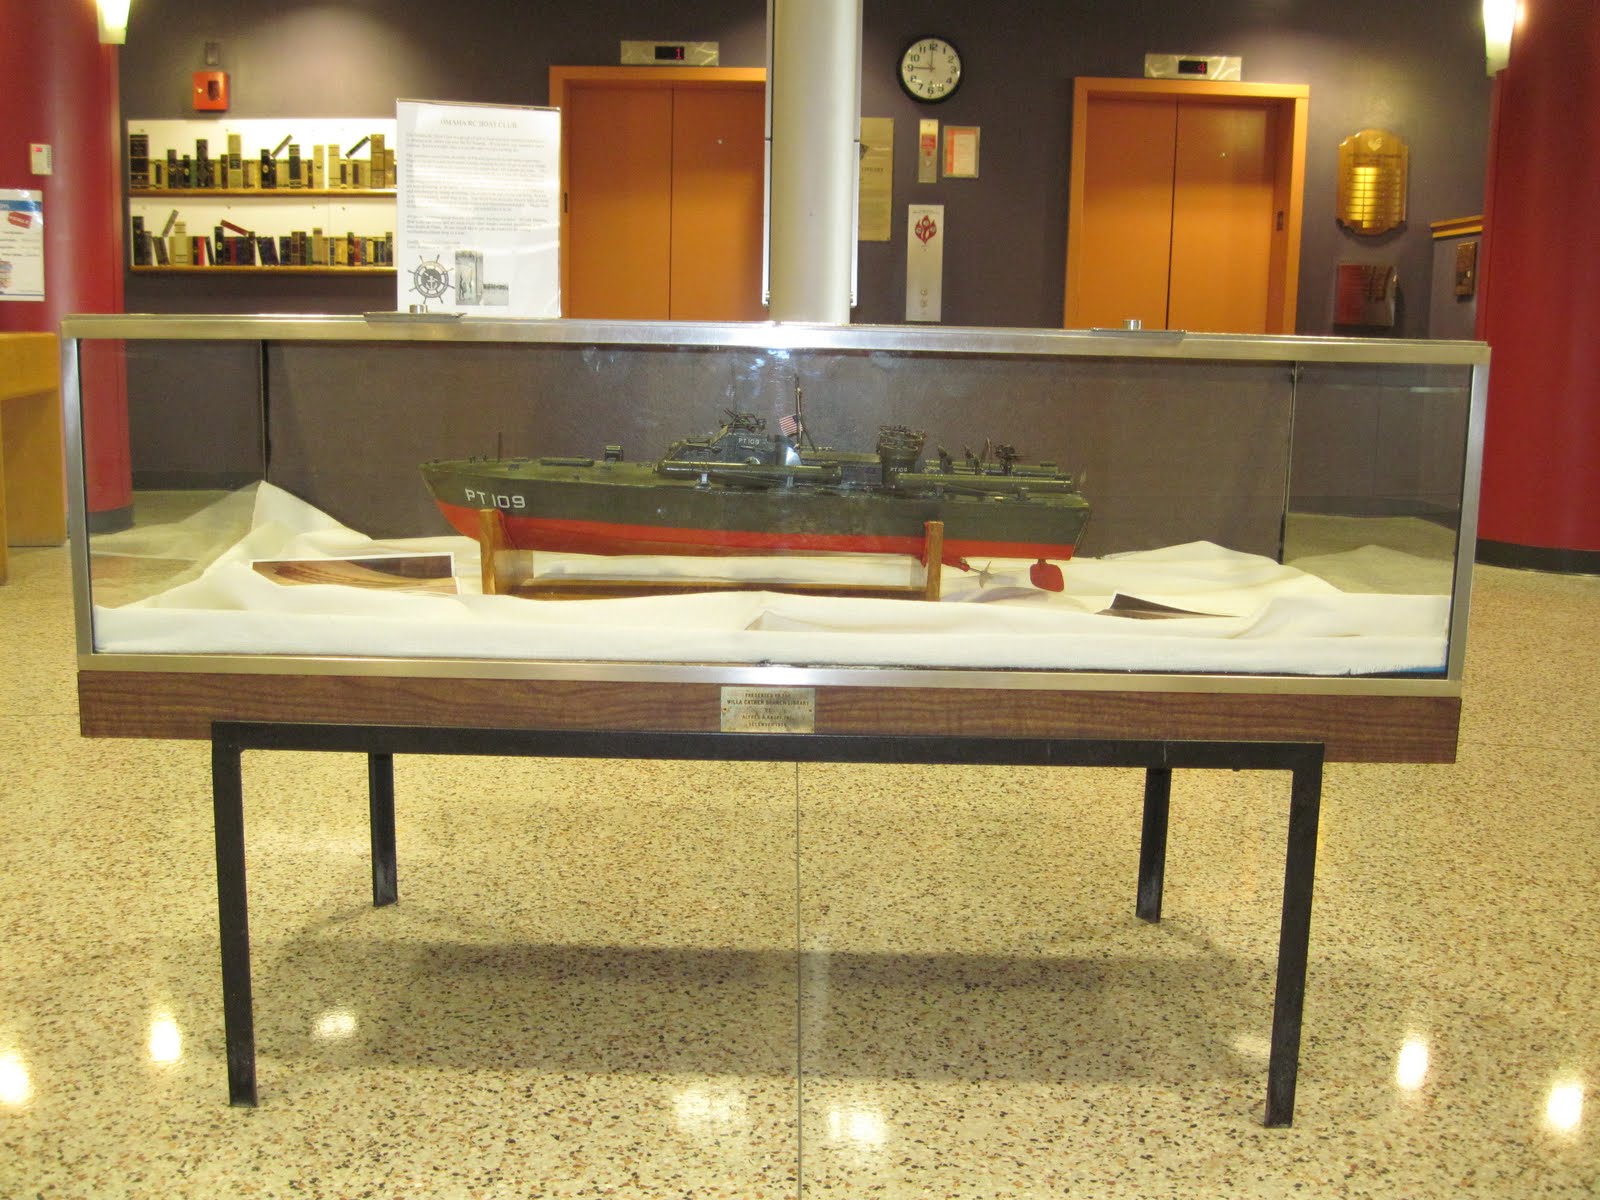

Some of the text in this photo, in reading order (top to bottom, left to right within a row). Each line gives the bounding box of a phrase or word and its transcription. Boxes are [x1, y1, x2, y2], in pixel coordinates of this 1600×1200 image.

[919, 46, 927, 54] 11
[929, 43, 938, 51] 12
[676, 47, 682, 60] 1
[910, 54, 920, 62] 10
[947, 55, 955, 64] 2
[907, 63, 914, 72] 9
[950, 65, 957, 74] 3
[917, 82, 924, 91] 7
[927, 86, 934, 95] 6
[464, 488, 526, 509] PT 109
